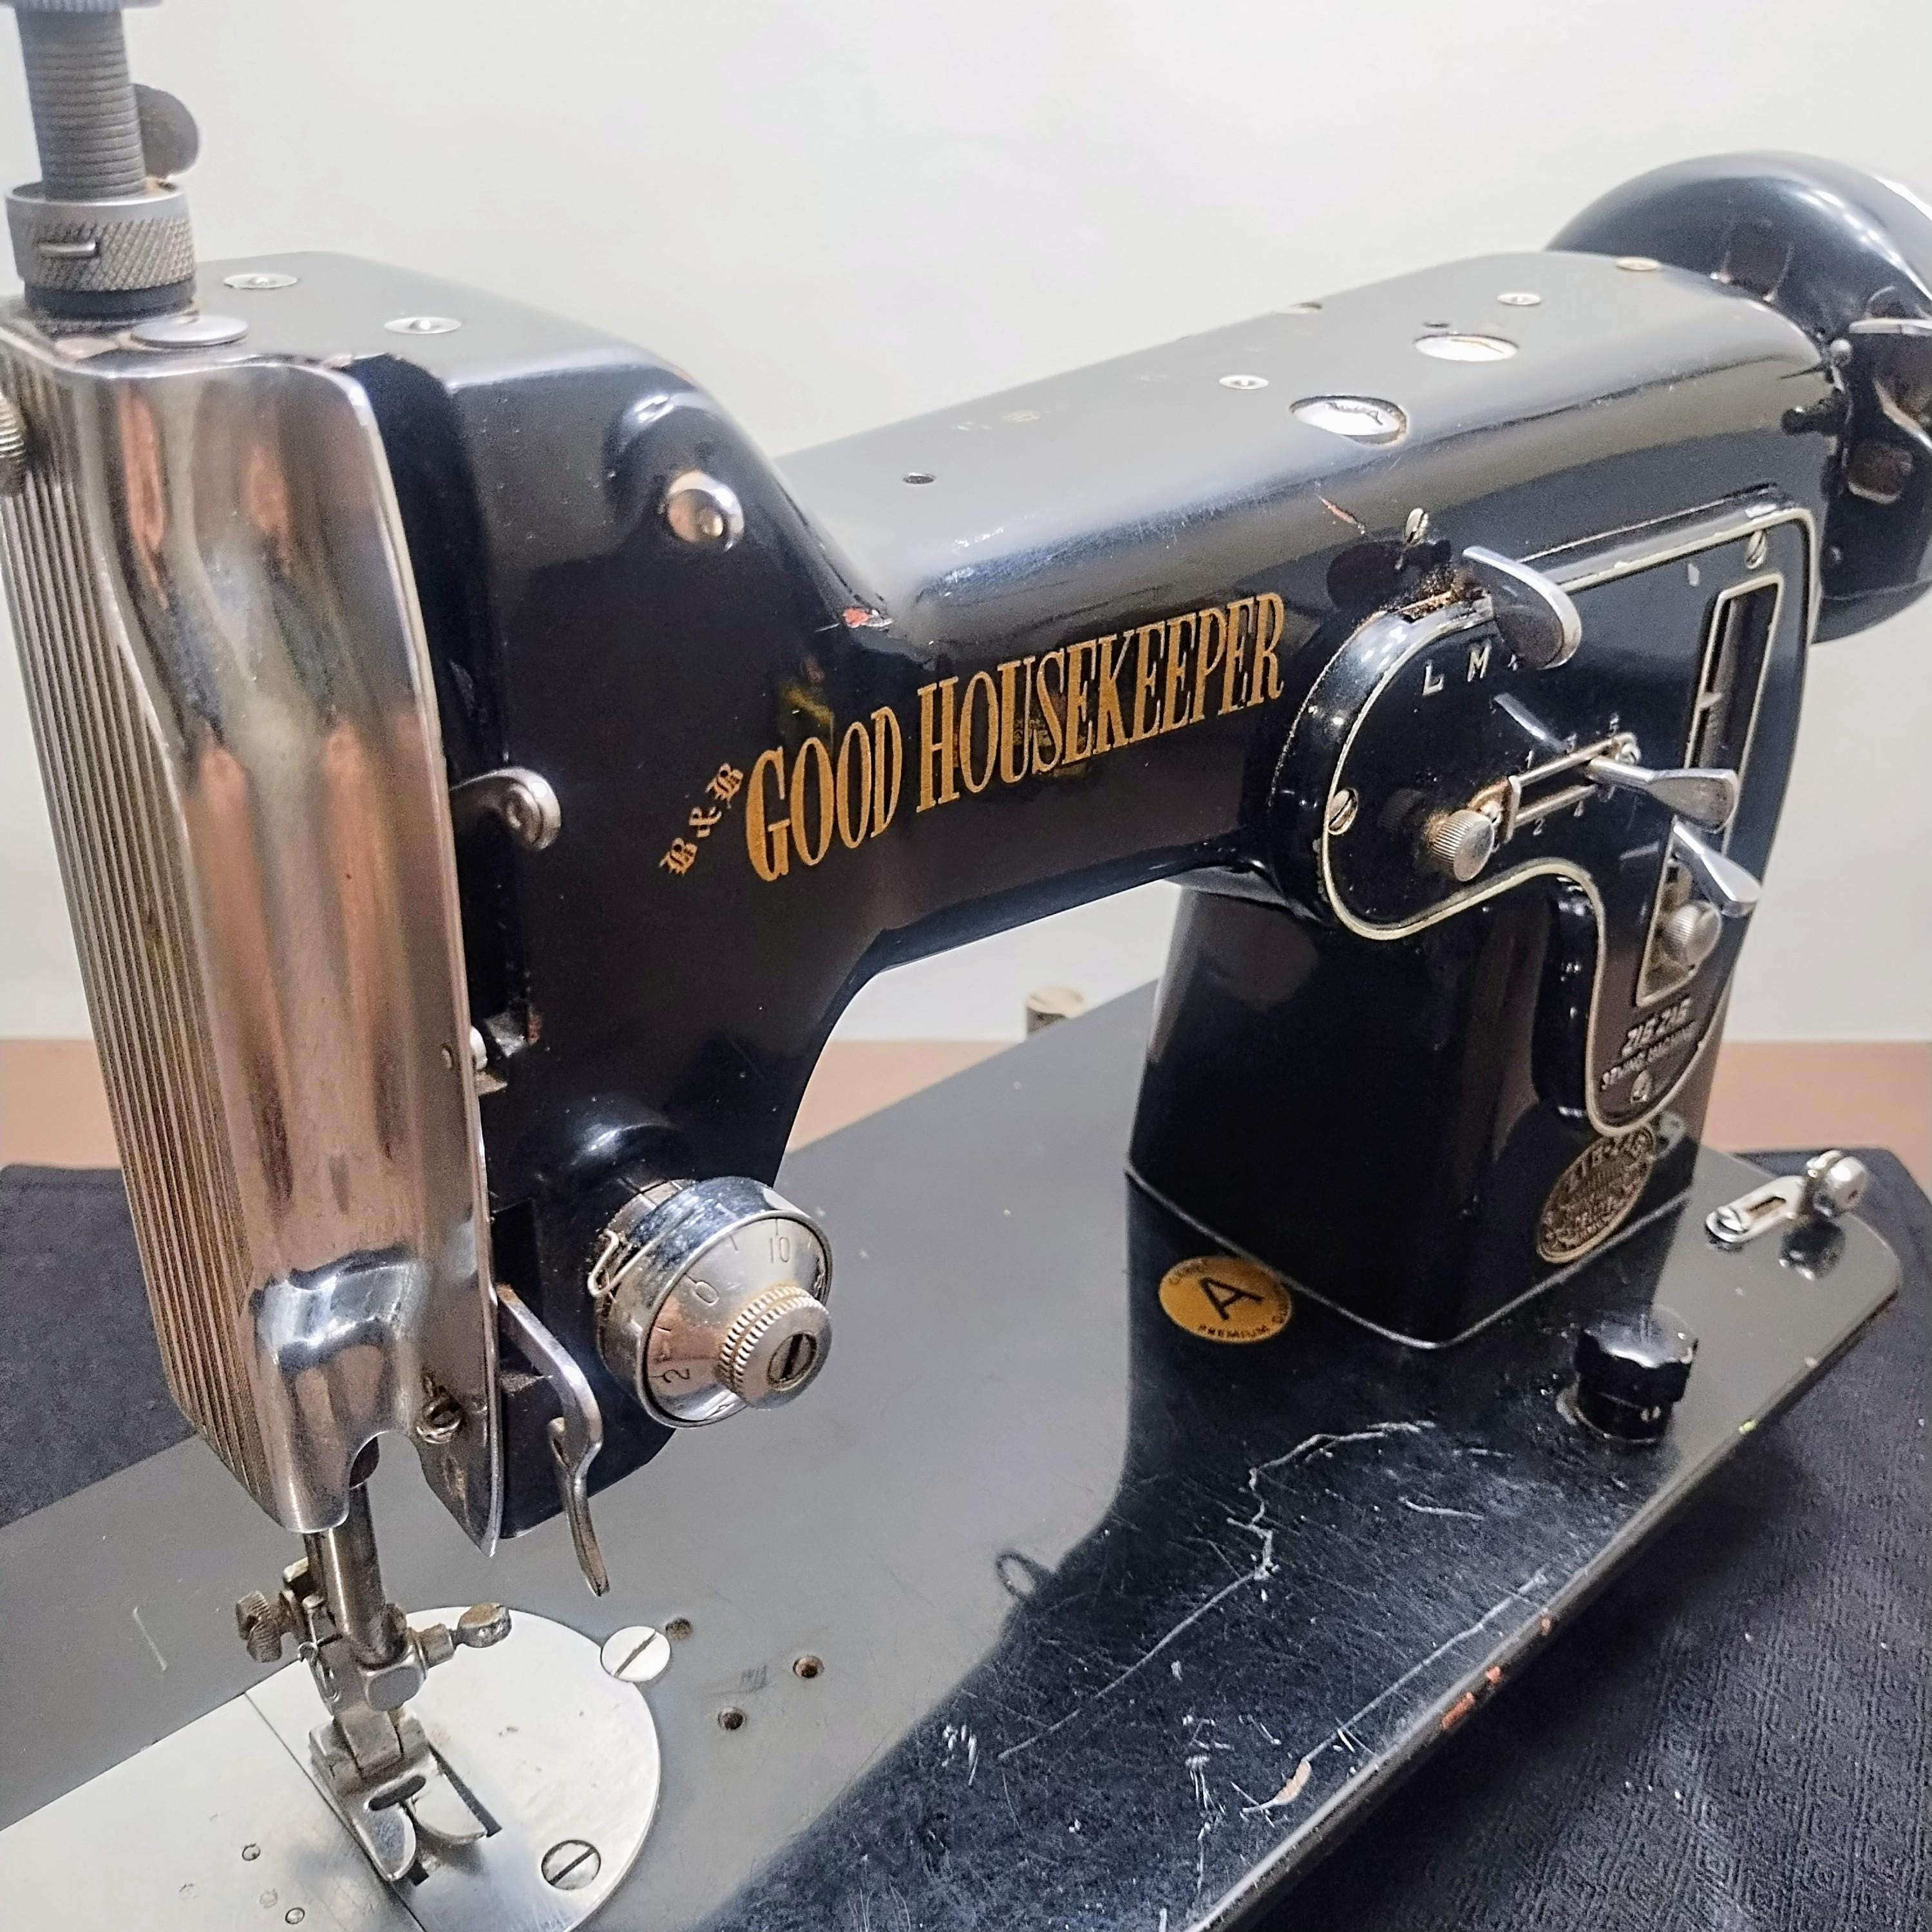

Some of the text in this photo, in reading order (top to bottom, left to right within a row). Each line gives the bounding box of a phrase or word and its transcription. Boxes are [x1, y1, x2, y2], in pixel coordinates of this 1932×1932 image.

[1423, 661, 1444, 696] L
[1468, 641, 1492, 683] M
[746, 592, 1285, 882] GOOD HOUSEKEEPER
[658, 763, 743, 876] B & B
[770, 1236, 790, 1263] 10
[695, 1281, 719, 1305] 0
[1200, 1277, 1264, 1321] A
[663, 1368, 690, 1383] 2
